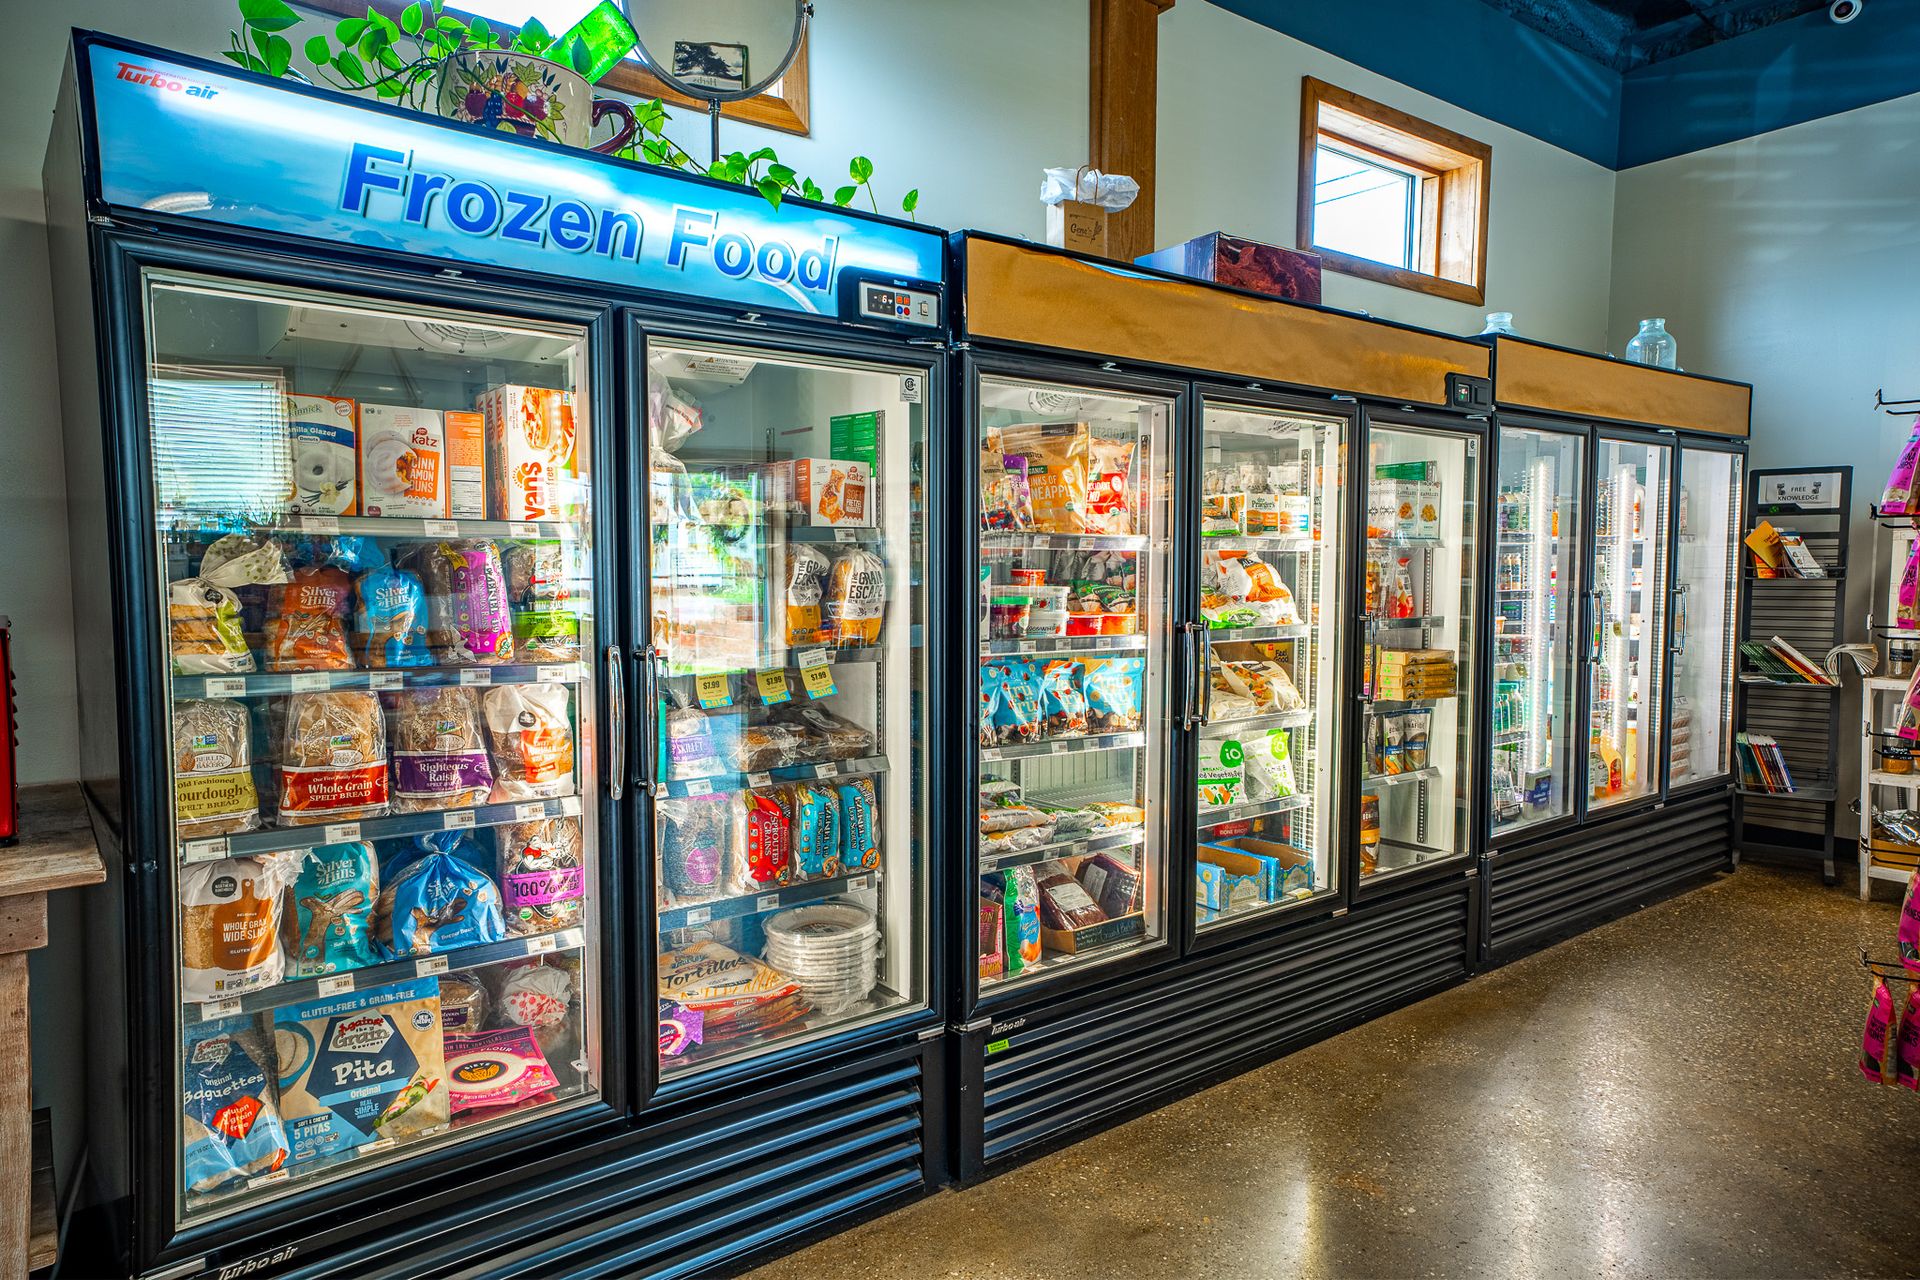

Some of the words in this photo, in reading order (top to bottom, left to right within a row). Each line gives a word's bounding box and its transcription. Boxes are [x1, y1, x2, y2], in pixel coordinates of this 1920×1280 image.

[117, 62, 183, 92] Turbo
[186, 86, 218, 100] air
[343, 143, 640, 266] Frozen
[666, 204, 839, 294] Food
[310, 427, 337, 438] Glazed
[412, 434, 438, 447] katz
[411, 457, 435, 471] CINN
[410, 470, 434, 482] AMON
[847, 471, 864, 483] katz
[1048, 474, 1057, 484] OF
[520, 461, 546, 521] vans
[301, 586, 338, 598] Silver
[376, 586, 410, 600] Silver
[849, 585, 884, 600] ESCAPE
[306, 596, 337, 607] Hills
[384, 594, 412, 608] Hills
[766, 675, 783, 686] $7.99
[811, 671, 827, 682] $7.99
[703, 680, 720, 690] $7.99
[813, 686, 833, 697] sale
[706, 698, 728, 708] sale
[767, 693, 787, 703] sale
[420, 762, 469, 774] Righteous
[177, 781, 192, 789] Old
[193, 778, 235, 787] Fashioned
[308, 783, 343, 794] Whole
[345, 780, 373, 791] Grain
[309, 794, 338, 802] SPELT
[340, 790, 371, 799] BREAD
[178, 803, 204, 812] SPELT
[207, 799, 240, 809] BREAD
[763, 821, 772, 856] GRAINS
[770, 816, 779, 865] SPROUTED
[316, 858, 355, 877] Silver
[325, 867, 356, 885] Hills
[514, 878, 557, 898] 100%
[223, 922, 248, 932] WHOLE
[223, 932, 245, 943] WIDE
[660, 956, 748, 989] Tortillas
[301, 1002, 357, 1019] GLUTEN-FREE
[360, 998, 366, 1007] &
[369, 989, 415, 1005] GRAIN-FREE
[991, 1022, 1013, 1035] Turbo
[1013, 1018, 1026, 1029] air
[332, 1028, 390, 1049] Grain
[351, 1040, 384, 1050] Gourmet
[204, 1072, 233, 1087] Original
[331, 1059, 396, 1086] Pita
[184, 1071, 265, 1105] Baguettes
[350, 1084, 382, 1099] Original
[222, 1103, 250, 1118] gluten
[354, 1102, 380, 1116] SIMPLE
[228, 1110, 253, 1124] grain
[229, 1122, 249, 1132] free
[294, 1128, 301, 1140] 5
[304, 1121, 331, 1138] PITAS
[219, 1257, 270, 1280] Turbo
[271, 1246, 299, 1264] air
